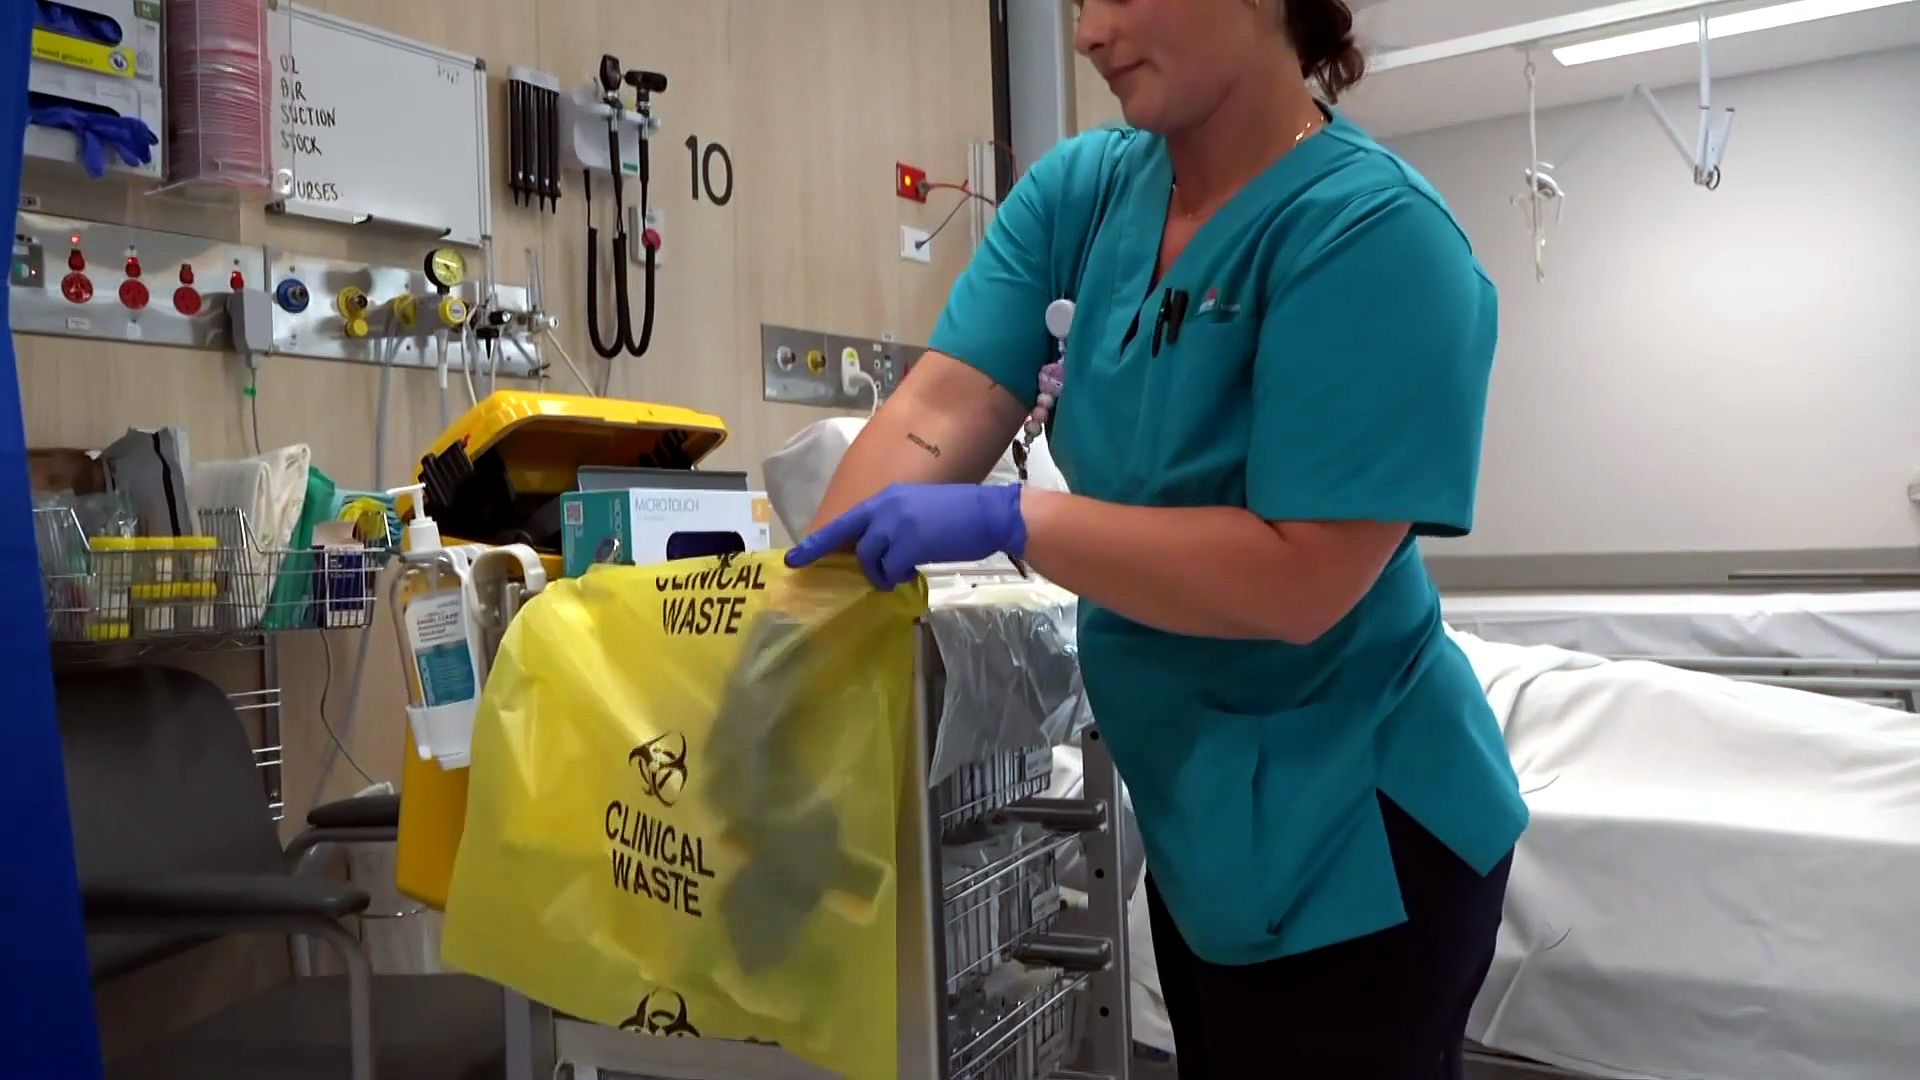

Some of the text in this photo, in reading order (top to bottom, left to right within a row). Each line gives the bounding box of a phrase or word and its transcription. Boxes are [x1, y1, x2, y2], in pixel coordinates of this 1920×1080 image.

[281, 103, 336, 128] SUCTION
[281, 131, 321, 155] STOCK
[685, 135, 733, 206] 10
[296, 181, 338, 201] URSES
[663, 597, 747, 635] WASTE
[605, 800, 715, 878] CLINICAL
[612, 848, 702, 917] WASTE
